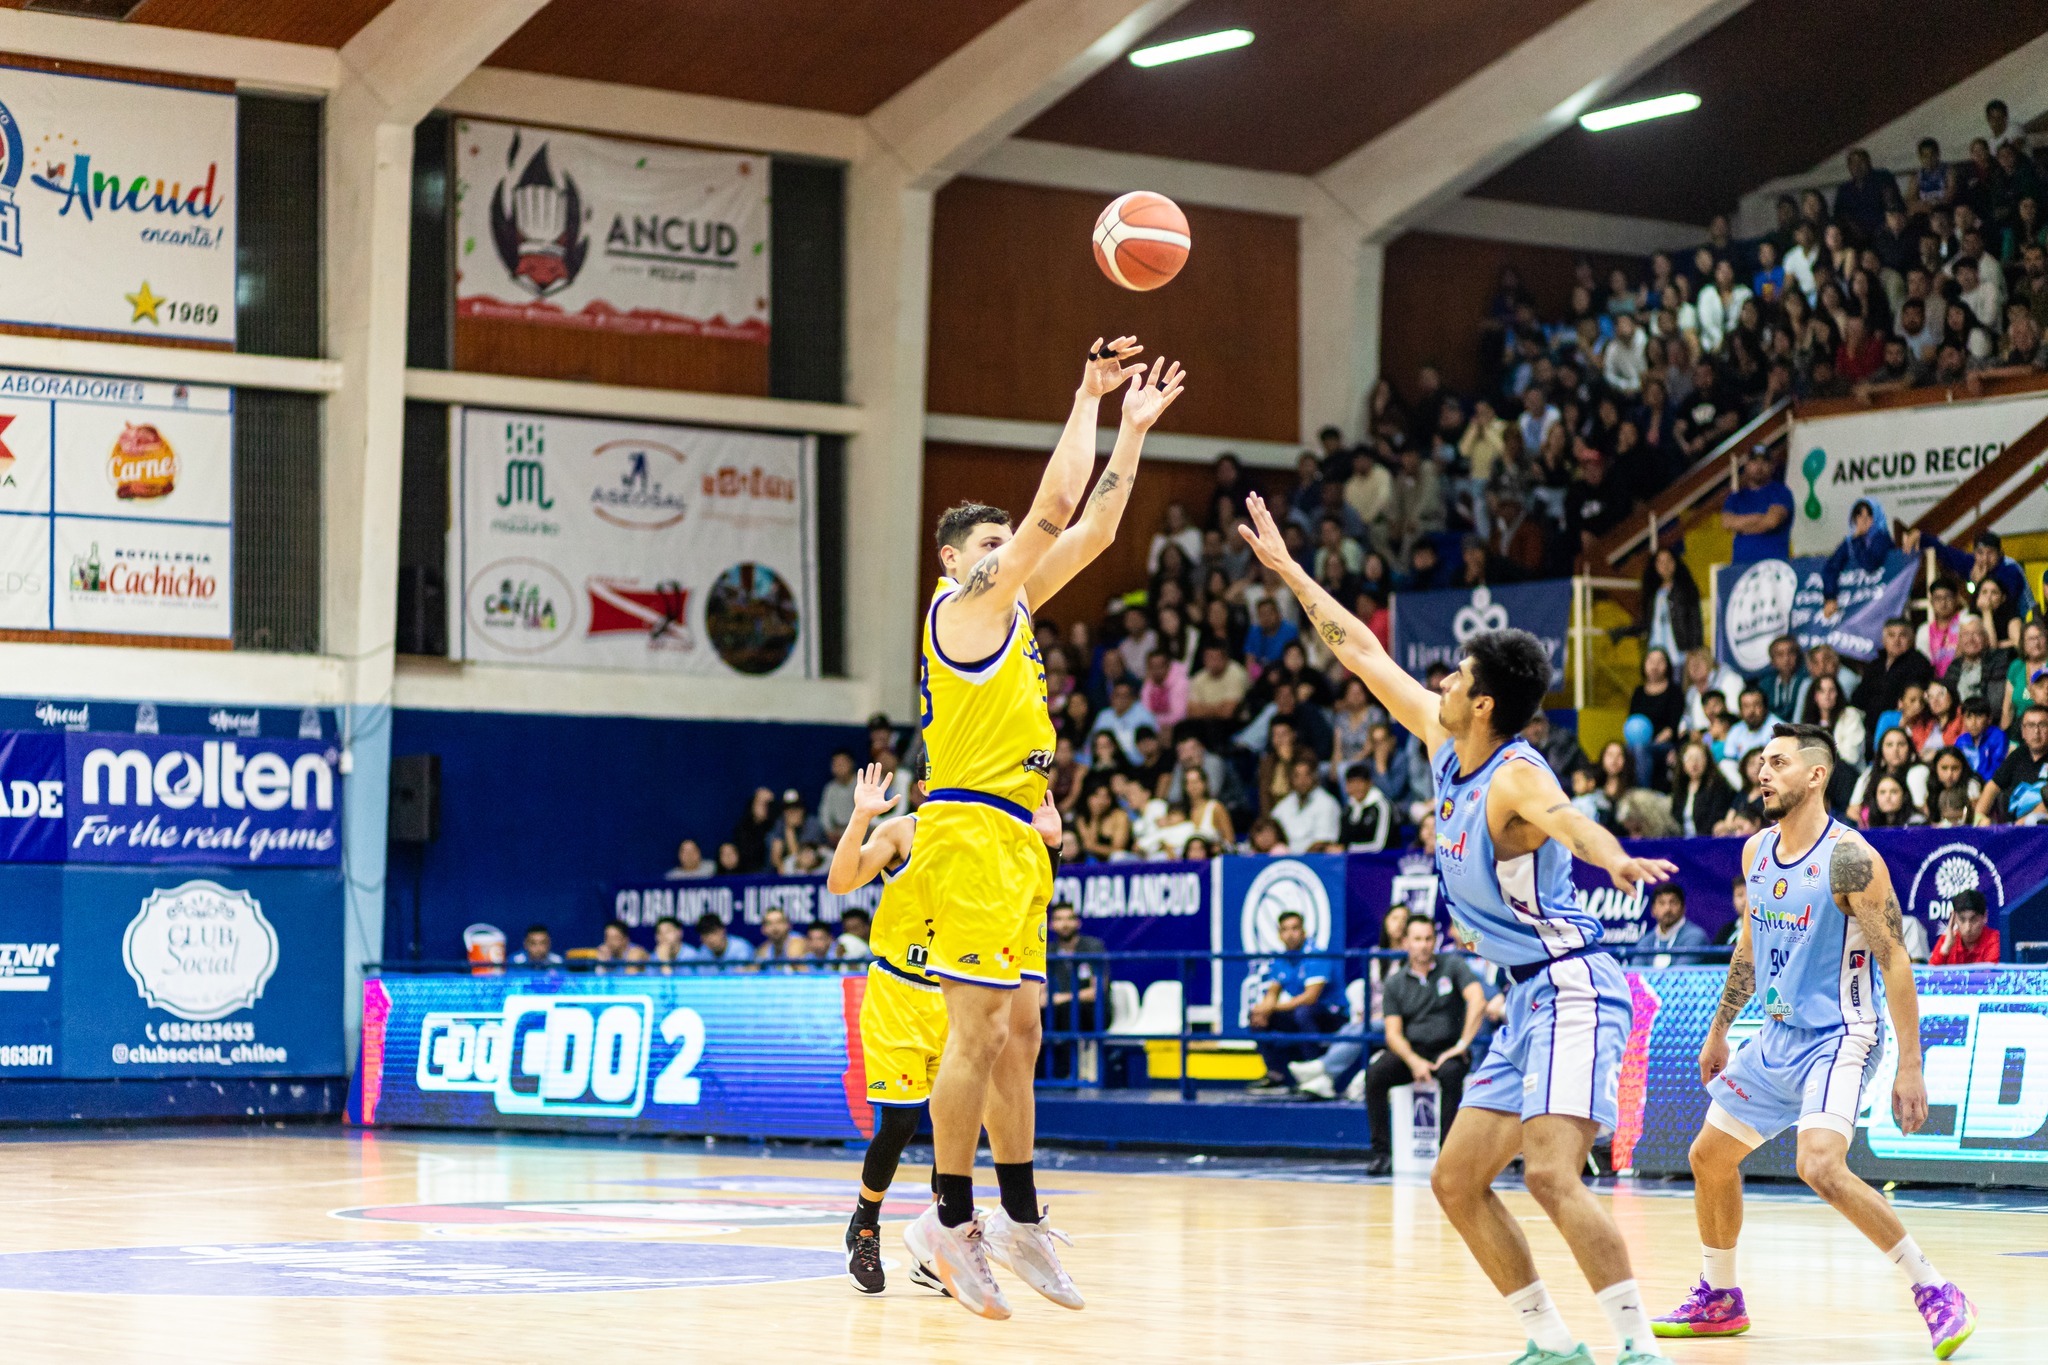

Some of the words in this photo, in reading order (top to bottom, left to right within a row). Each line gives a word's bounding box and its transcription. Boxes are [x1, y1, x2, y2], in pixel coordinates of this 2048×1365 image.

[32, 154, 225, 222] Ancud
[606, 213, 738, 258] ANCUD
[167, 301, 219, 324] 1989
[1832, 452, 1916, 486] ANCUD
[109, 562, 217, 600] Cachicho
[82, 741, 334, 811] molten
[72, 814, 127, 849] For
[128, 813, 181, 848] the
[181, 816, 252, 849] real
[249, 826, 335, 862] game
[1127, 872, 1201, 915] ANCUD
[168, 923, 233, 948] CLUB
[1750, 902, 1813, 933] Ancud
[161, 935, 240, 976] Social
